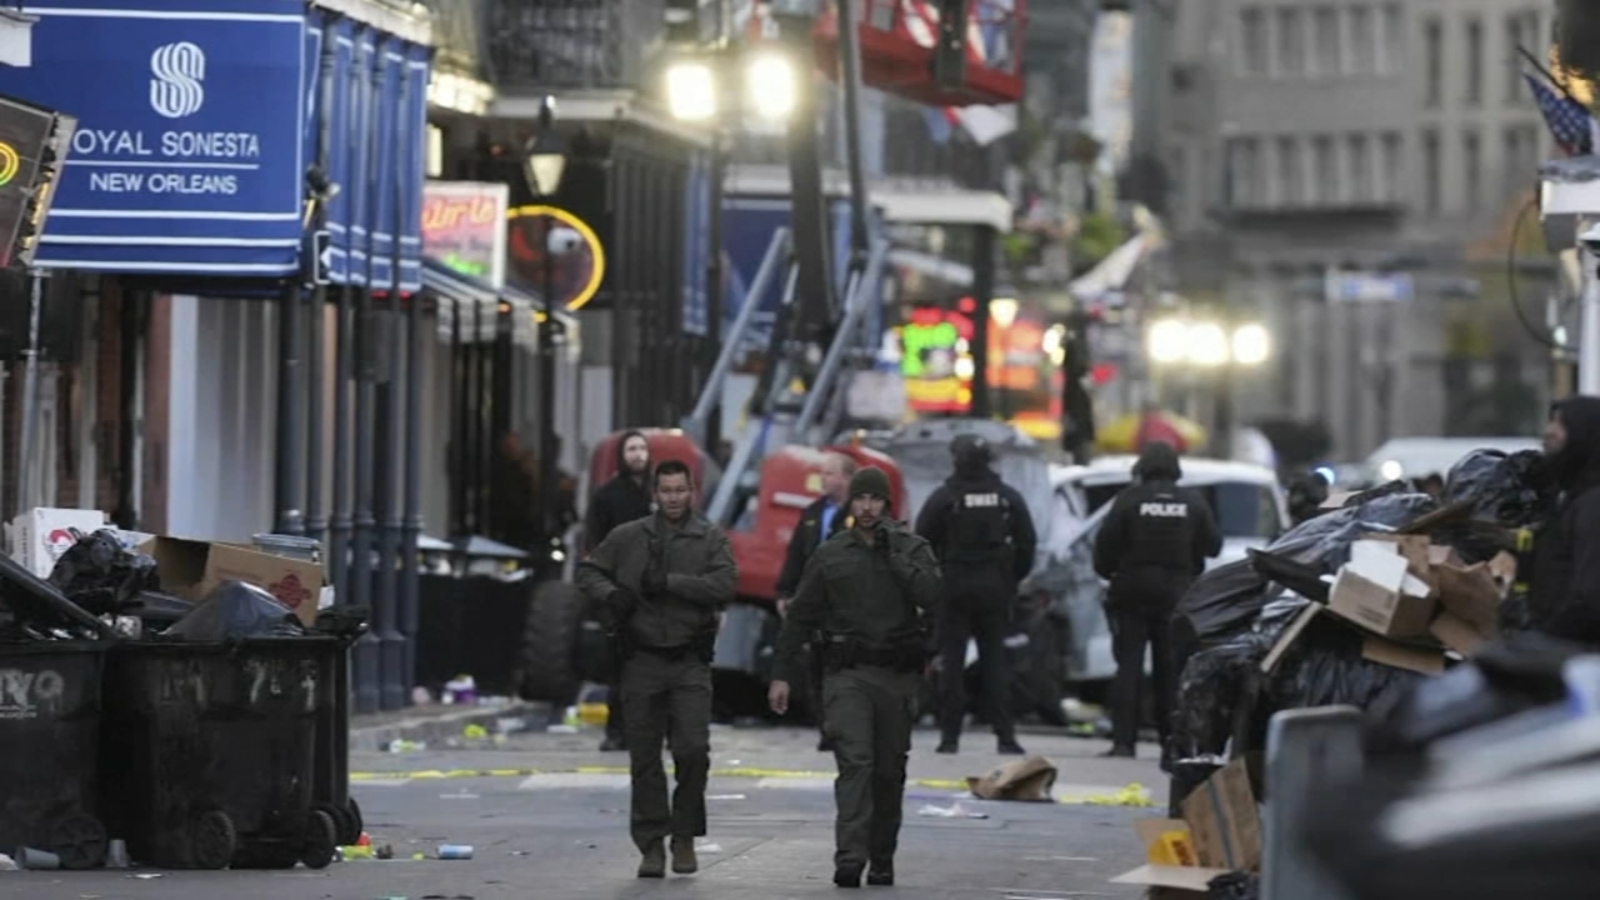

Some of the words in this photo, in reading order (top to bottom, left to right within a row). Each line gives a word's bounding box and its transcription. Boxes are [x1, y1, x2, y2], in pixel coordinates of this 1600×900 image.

[72, 129, 153, 154] OYAL
[161, 131, 260, 157] SONESTA
[90, 173, 144, 192] NEW
[148, 174, 238, 194] ORLEANS
[1140, 502, 1188, 517] POLICE
